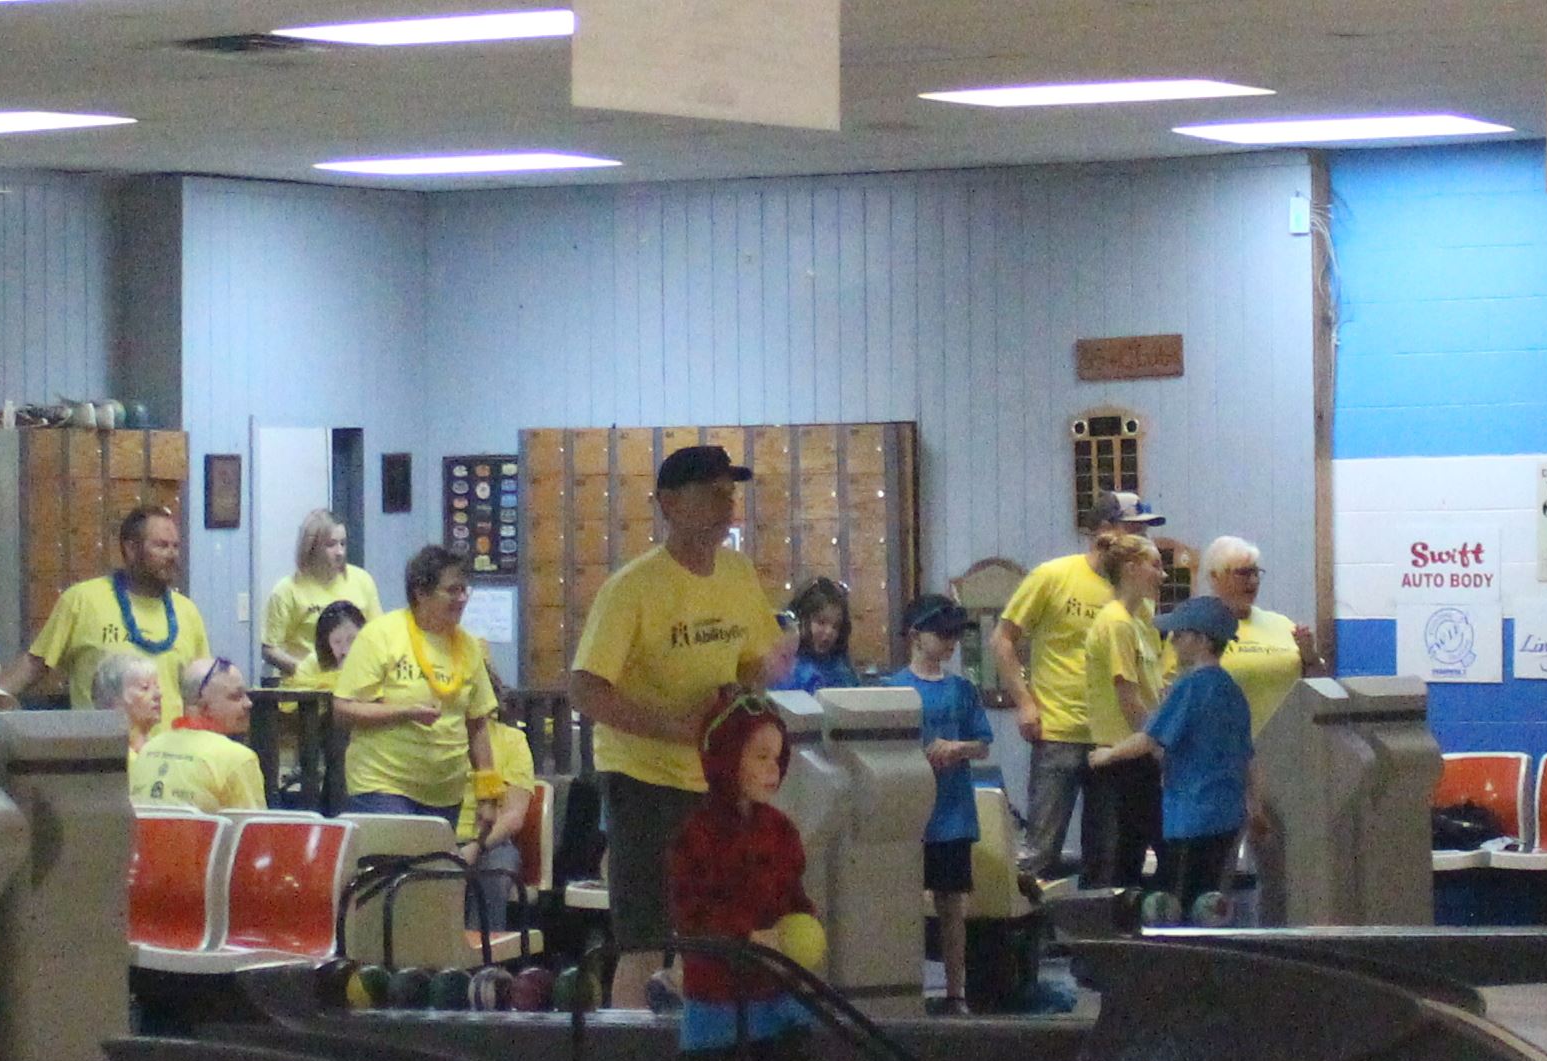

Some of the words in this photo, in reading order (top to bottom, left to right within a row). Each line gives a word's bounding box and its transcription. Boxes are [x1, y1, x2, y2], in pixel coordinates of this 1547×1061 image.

[1410, 541, 1485, 568] Swift
[1402, 573, 1444, 588] AUTO
[1450, 573, 1493, 588] BODY
